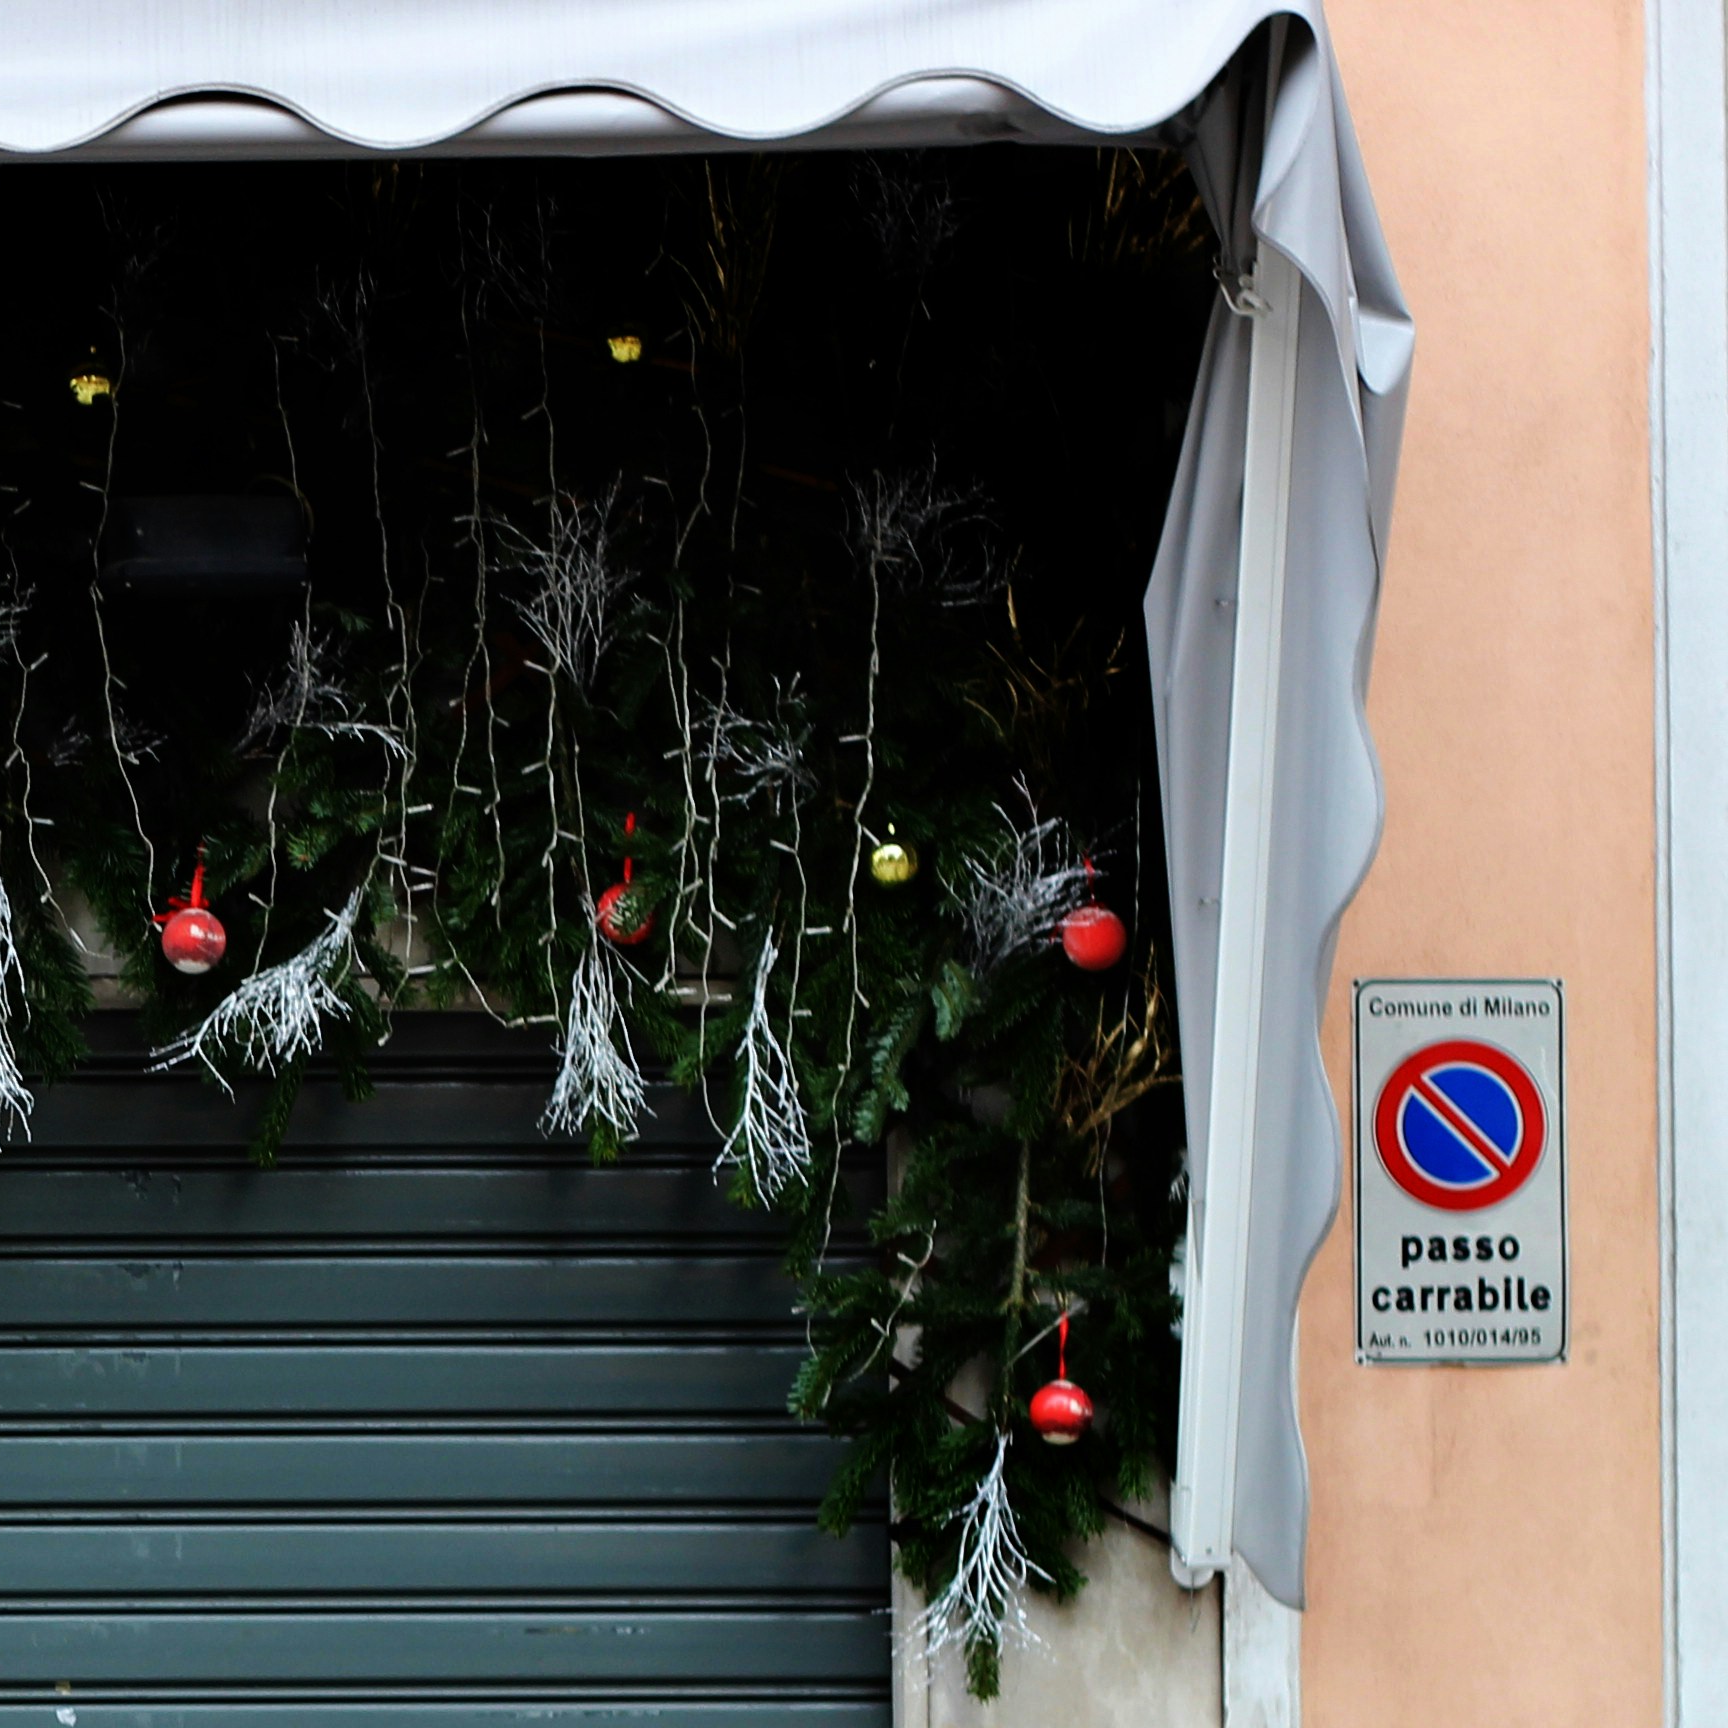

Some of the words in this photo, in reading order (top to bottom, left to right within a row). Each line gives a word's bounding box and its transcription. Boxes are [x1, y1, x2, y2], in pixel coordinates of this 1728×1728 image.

[1368, 996, 1453, 1018] Comune
[1459, 995, 1478, 1017] di
[1483, 996, 1551, 1018] Milano
[1401, 1235, 1521, 1268] passo
[1371, 1277, 1552, 1313] carrabile
